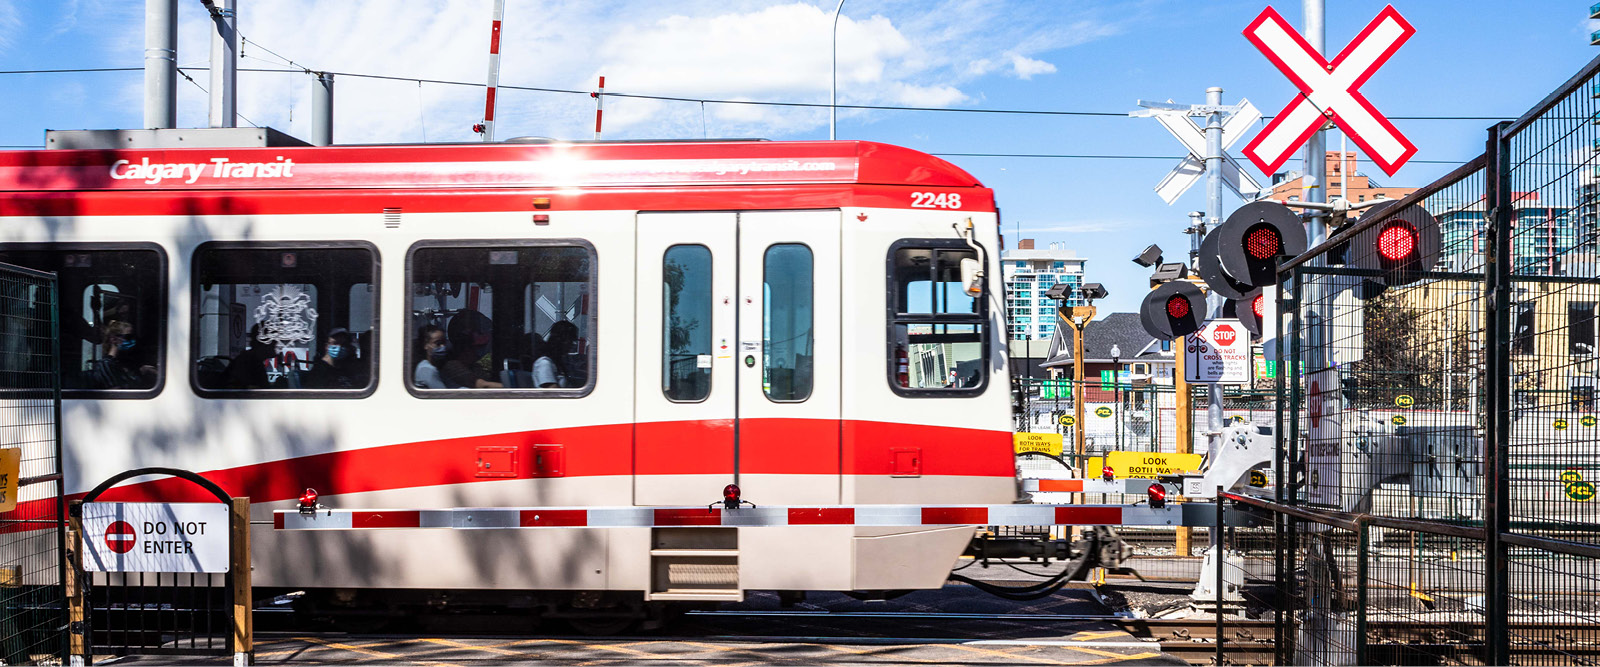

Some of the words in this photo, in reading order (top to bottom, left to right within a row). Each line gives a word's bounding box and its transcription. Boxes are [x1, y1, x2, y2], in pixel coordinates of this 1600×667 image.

[110, 157, 205, 185] Calgary
[210, 156, 295, 180] Transit
[694, 159, 836, 176] algarytransit.com
[911, 191, 962, 209] 2248
[1214, 331, 1235, 340] STOP
[1143, 457, 1167, 465] LOOK
[143, 521, 167, 536] DO
[174, 521, 207, 536] NOT
[143, 540, 193, 555] ENTER
